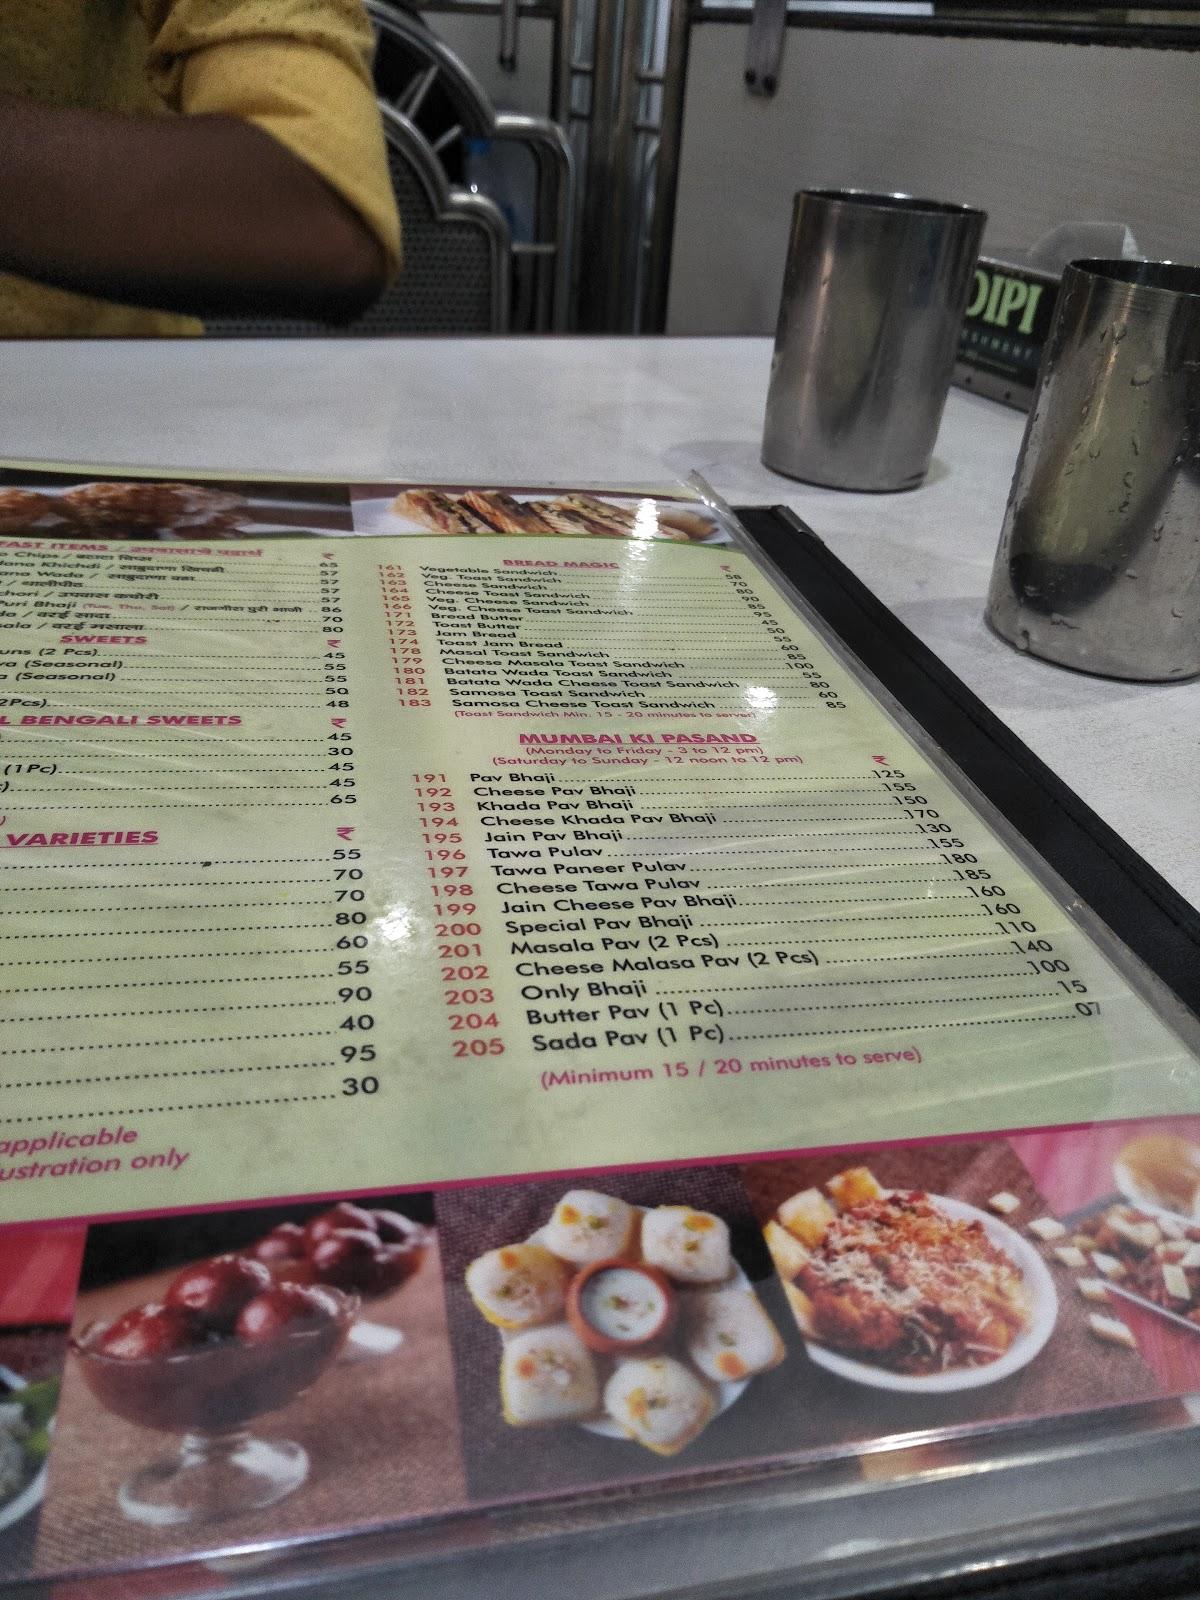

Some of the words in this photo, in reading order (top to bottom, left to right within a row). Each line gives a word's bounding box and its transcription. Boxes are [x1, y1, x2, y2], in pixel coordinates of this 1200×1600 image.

[50, 543, 108, 551] ITEMS
[14, 551, 59, 559] Chips
[419, 566, 489, 574] Vegetable
[34, 601, 77, 609] Bhaji
[60, 635, 147, 644] SWEETS
[64, 648, 98, 657] Pcs)
[24, 659, 124, 670] (Seasonal)
[324, 663, 346, 671] 55
[15, 672, 116, 682] (Seasonal)
[325, 675, 347, 683] 55
[325, 687, 349, 695] 50
[397, 688, 429, 696] 182
[449, 689, 516, 697] Samosa
[568, 690, 645, 698] Sandwich
[819, 691, 838, 699] 60
[326, 700, 349, 708] 48
[400, 699, 431, 707] 183
[526, 700, 588, 708] Cheese
[591, 700, 634, 709] Toast
[638, 700, 716, 710] Sandwich
[21, 715, 138, 725] BENGALI
[145, 715, 243, 725] SWEETS
[327, 733, 352, 741] 45
[519, 733, 622, 744] MUMBAI
[630, 734, 654, 744] KI
[662, 732, 757, 744] PASAND
[328, 747, 353, 756] 30
[328, 762, 354, 771] 45
[329, 778, 356, 787] 45
[413, 774, 445, 782] 191
[470, 773, 502, 782] Pav
[509, 773, 555, 784] Bhaji
[872, 770, 905, 778] 125
[415, 788, 452, 797] 192
[474, 787, 545, 796] Cheese
[552, 787, 583, 796] Pav
[591, 786, 636, 797] Bhaji
[882, 782, 916, 792] 155
[330, 795, 357, 804] 65
[418, 802, 455, 812] 193
[477, 801, 540, 811] Khada
[548, 801, 580, 810] Pav
[587, 800, 634, 811] Bhaji
[893, 796, 928, 805] 150
[6, 831, 159, 846] VARIETIES
[422, 833, 462, 843] 195
[484, 832, 526, 843] Jain
[532, 831, 566, 841] Pav
[575, 830, 622, 842] Bhaji
[916, 823, 951, 834] 130
[333, 849, 361, 860] 55
[425, 850, 465, 860] 196
[487, 849, 541, 859] Tawa
[549, 847, 602, 857] Pulav
[928, 838, 964, 848] 155
[428, 867, 468, 878] 197
[491, 865, 546, 876] Tawa
[554, 863, 623, 875] Paneer
[632, 861, 686, 872] Pulav
[940, 853, 978, 864] 180
[333, 869, 363, 880] 70
[431, 885, 473, 896] 198
[497, 883, 577, 894] Cheese
[583, 880, 639, 892] Tawa
[647, 877, 700, 889] Pulav
[953, 869, 992, 880] 185
[334, 890, 365, 902] 70
[335, 912, 367, 925] 80
[435, 923, 482, 936] 200
[505, 918, 586, 936] Special
[594, 918, 632, 930] Pav
[639, 915, 693, 930] Bhaji
[981, 903, 1021, 916] 160
[336, 935, 368, 949] 60
[338, 960, 370, 975] 55
[444, 988, 494, 1005] 203
[521, 983, 580, 1003] Only
[588, 980, 647, 997] Bhaji
[1027, 960, 1070, 975] 100
[338, 987, 373, 1002] 90
[448, 1013, 500, 1030] 204
[526, 1008, 601, 1025] Butter
[608, 1005, 649, 1019] Pav
[659, 1002, 678, 1021] (1
[689, 1000, 724, 1017] Pc)
[1057, 980, 1087, 994] 15
[339, 1015, 374, 1031] 40
[452, 1038, 506, 1056] 205
[532, 1034, 597, 1052] Sada
[605, 1030, 648, 1045] Pav
[657, 1027, 677, 1047] (1
[689, 1024, 724, 1043] Pc)
[340, 1045, 377, 1063] 95
[541, 1066, 654, 1090] (Minimum
[663, 1062, 689, 1077] 15
[342, 1076, 379, 1097] 30
[130, 1148, 190, 1171] only
